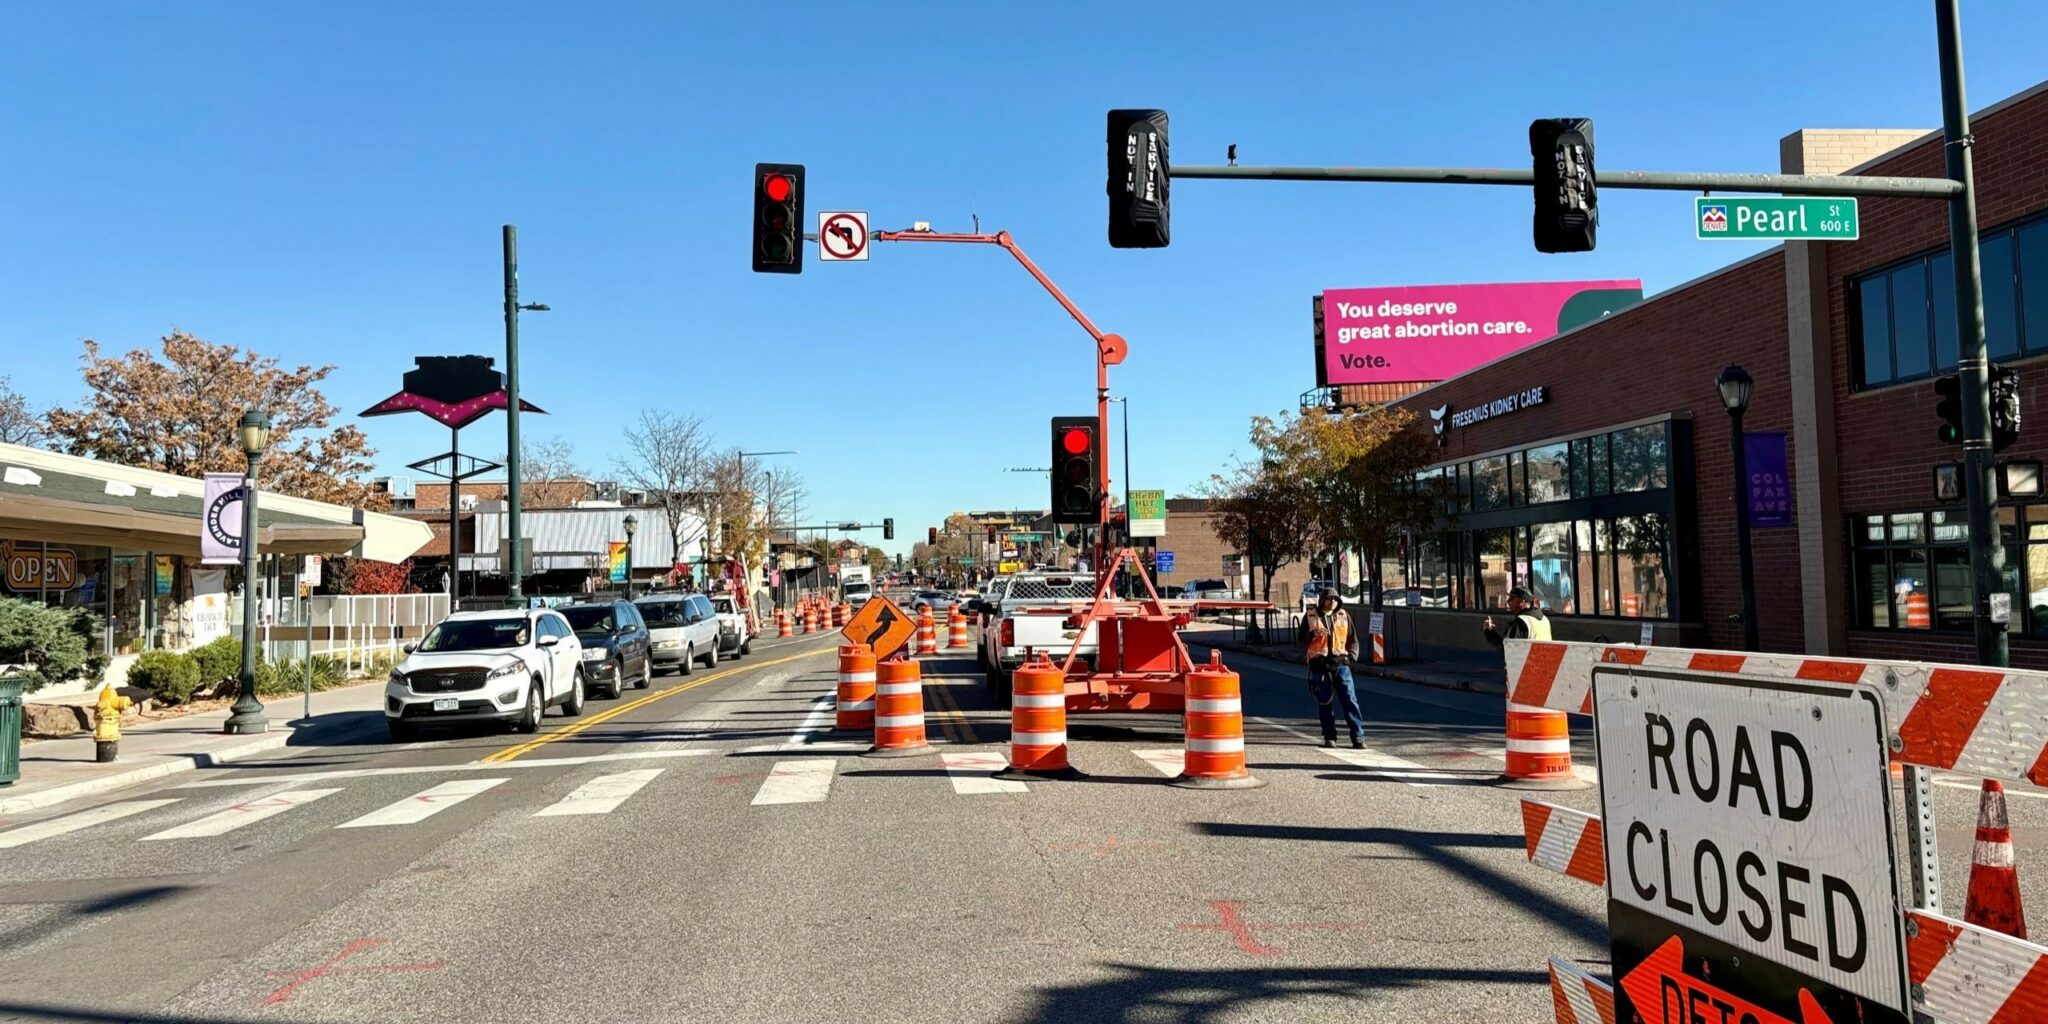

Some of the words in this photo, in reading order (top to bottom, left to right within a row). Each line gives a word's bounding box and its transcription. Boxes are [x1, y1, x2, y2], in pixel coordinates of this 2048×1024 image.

[1127, 134, 1137, 165] NOT
[1145, 132, 1157, 201] SERVICE
[1555, 151, 1566, 179] NOT
[1126, 172, 1135, 192] IN
[1559, 186, 1569, 205] IN
[1736, 204, 1808, 232] Pearl
[1829, 205, 1840, 217] St
[1703, 222, 1728, 231] DENVER
[1820, 220, 1842, 232] 600
[1844, 220, 1850, 232] E
[1337, 302, 1374, 319] You
[1377, 300, 1458, 317] deserve
[1338, 323, 1392, 344] great
[1395, 319, 1480, 339] abortion
[1483, 319, 1533, 336] care.
[1340, 353, 1391, 370] Vote.
[1452, 403, 1489, 429] FRESENIUS
[1490, 393, 1519, 417] KIDNEY
[1520, 386, 1543, 409] CARE
[1751, 473, 1785, 484] COL
[1752, 487, 1786, 498] FAX
[1754, 500, 1787, 512] AVE
[210, 505, 241, 547] LAVENDER
[11, 557, 71, 582] OPEN
[1645, 711, 1814, 823] ROAD
[1626, 820, 1867, 974] CLOSED
